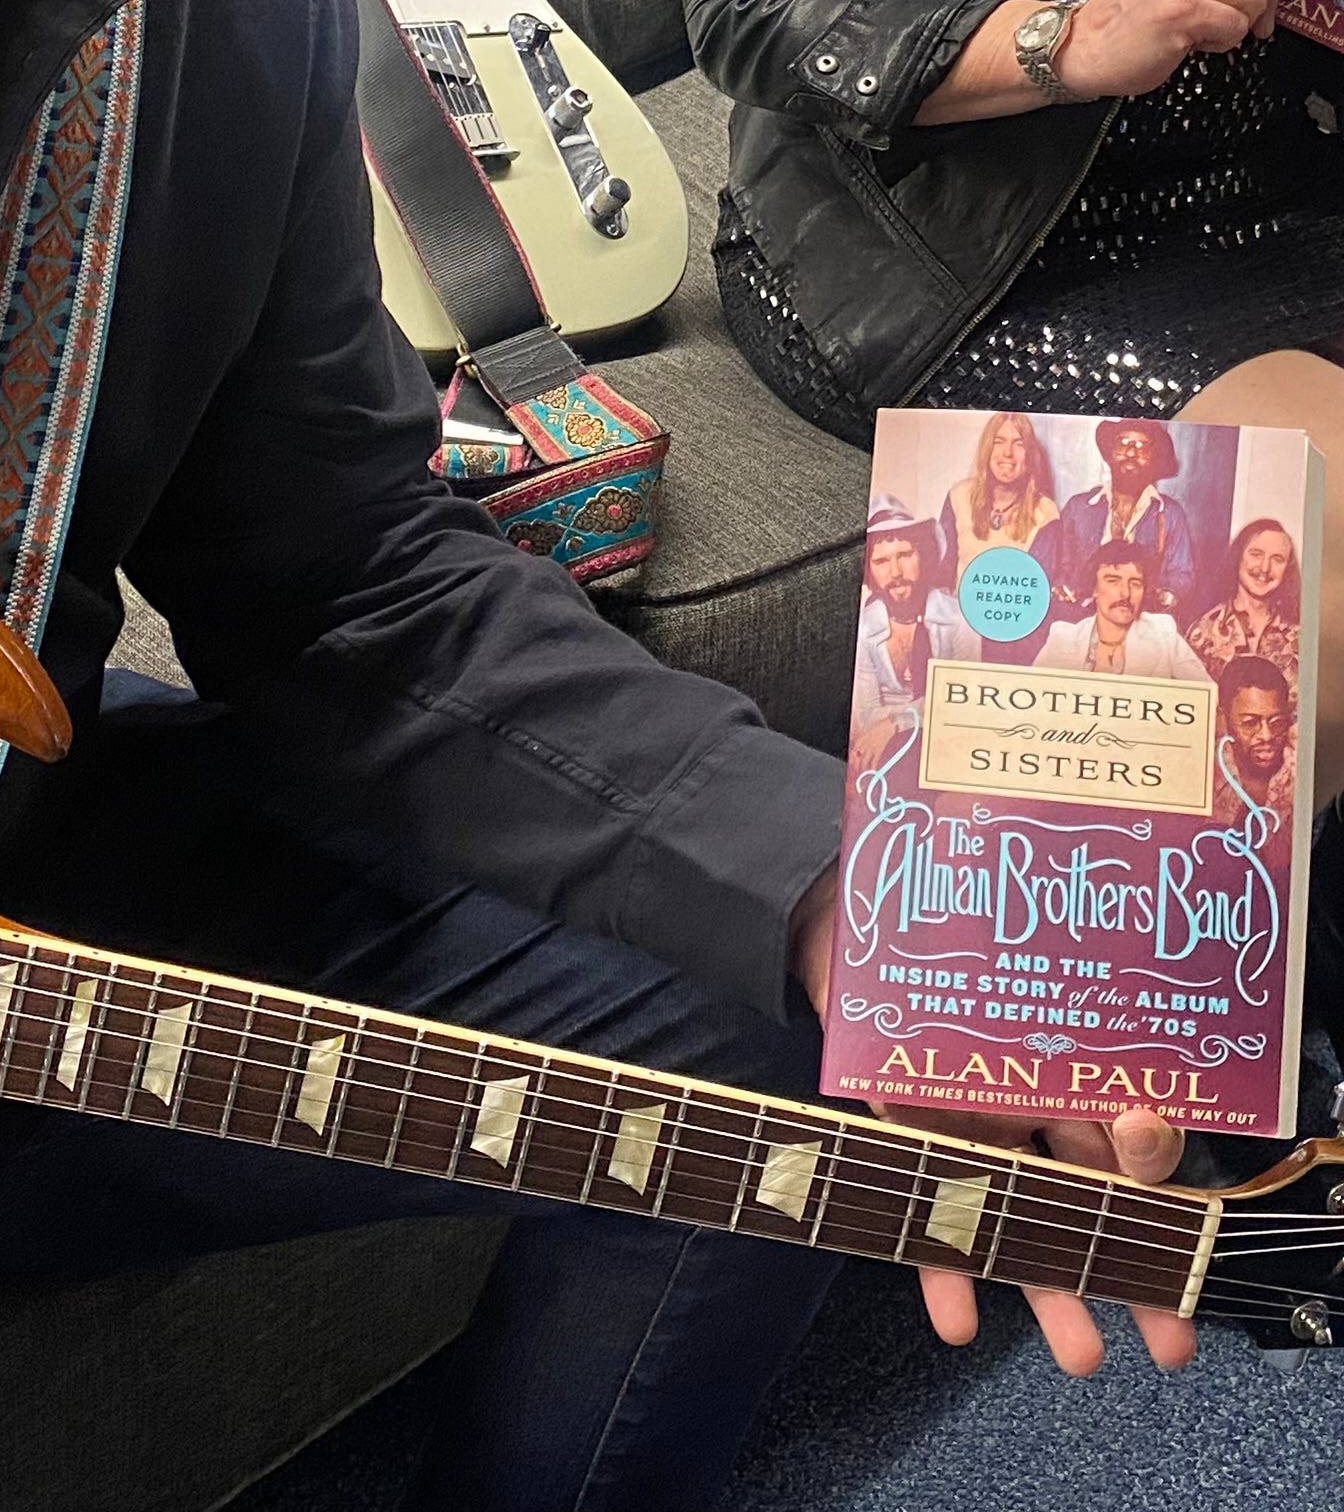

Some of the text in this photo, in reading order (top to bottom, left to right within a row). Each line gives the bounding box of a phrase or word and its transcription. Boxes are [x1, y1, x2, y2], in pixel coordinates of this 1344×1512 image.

[971, 572, 1039, 589] ADVANCE
[975, 590, 1033, 607] READER
[983, 608, 1021, 623] COPY
[944, 682, 1196, 725] BROTHERS
[1041, 722, 1097, 745] and
[969, 749, 1164, 787] SISTERS
[937, 817, 984, 857] The
[856, 823, 1255, 961] Allman Brothers Band
[995, 952, 1112, 980] AND THE
[879, 964, 1230, 1015] INSIDE STORY of the ALBUM
[907, 993, 1197, 1037] THAT DEFINED the '70S
[875, 1044, 1219, 1104] ALAN PAUL
[839, 1076, 872, 1091] NEW
[876, 1079, 913, 1096] YORK
[919, 1085, 964, 1100] TIMES
[967, 1090, 1065, 1109] BESTSELLING
[1069, 1098, 1128, 1113] AUTHOR
[1157, 1105, 1187, 1119] ONE
[1191, 1107, 1223, 1123] WAY
[1226, 1112, 1257, 1126] OUT
